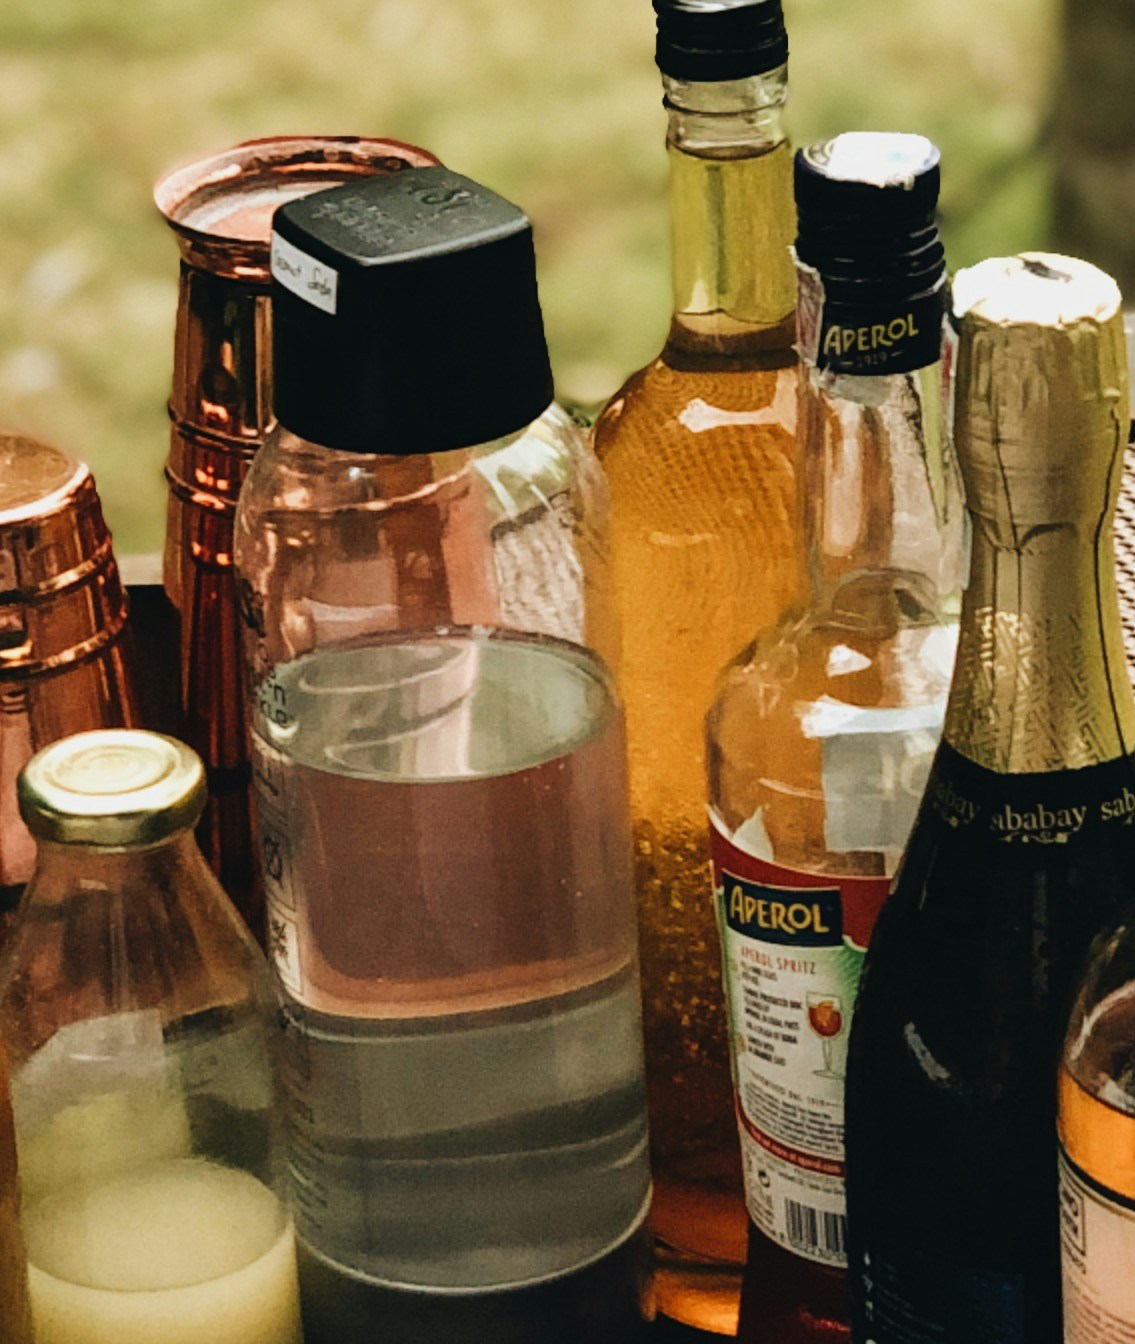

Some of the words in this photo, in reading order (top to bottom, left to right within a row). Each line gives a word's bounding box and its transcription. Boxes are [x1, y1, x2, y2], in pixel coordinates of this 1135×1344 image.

[823, 313, 919, 356] APEROL
[730, 885, 830, 936] APEROL
[776, 957, 817, 975] SPRITZ
